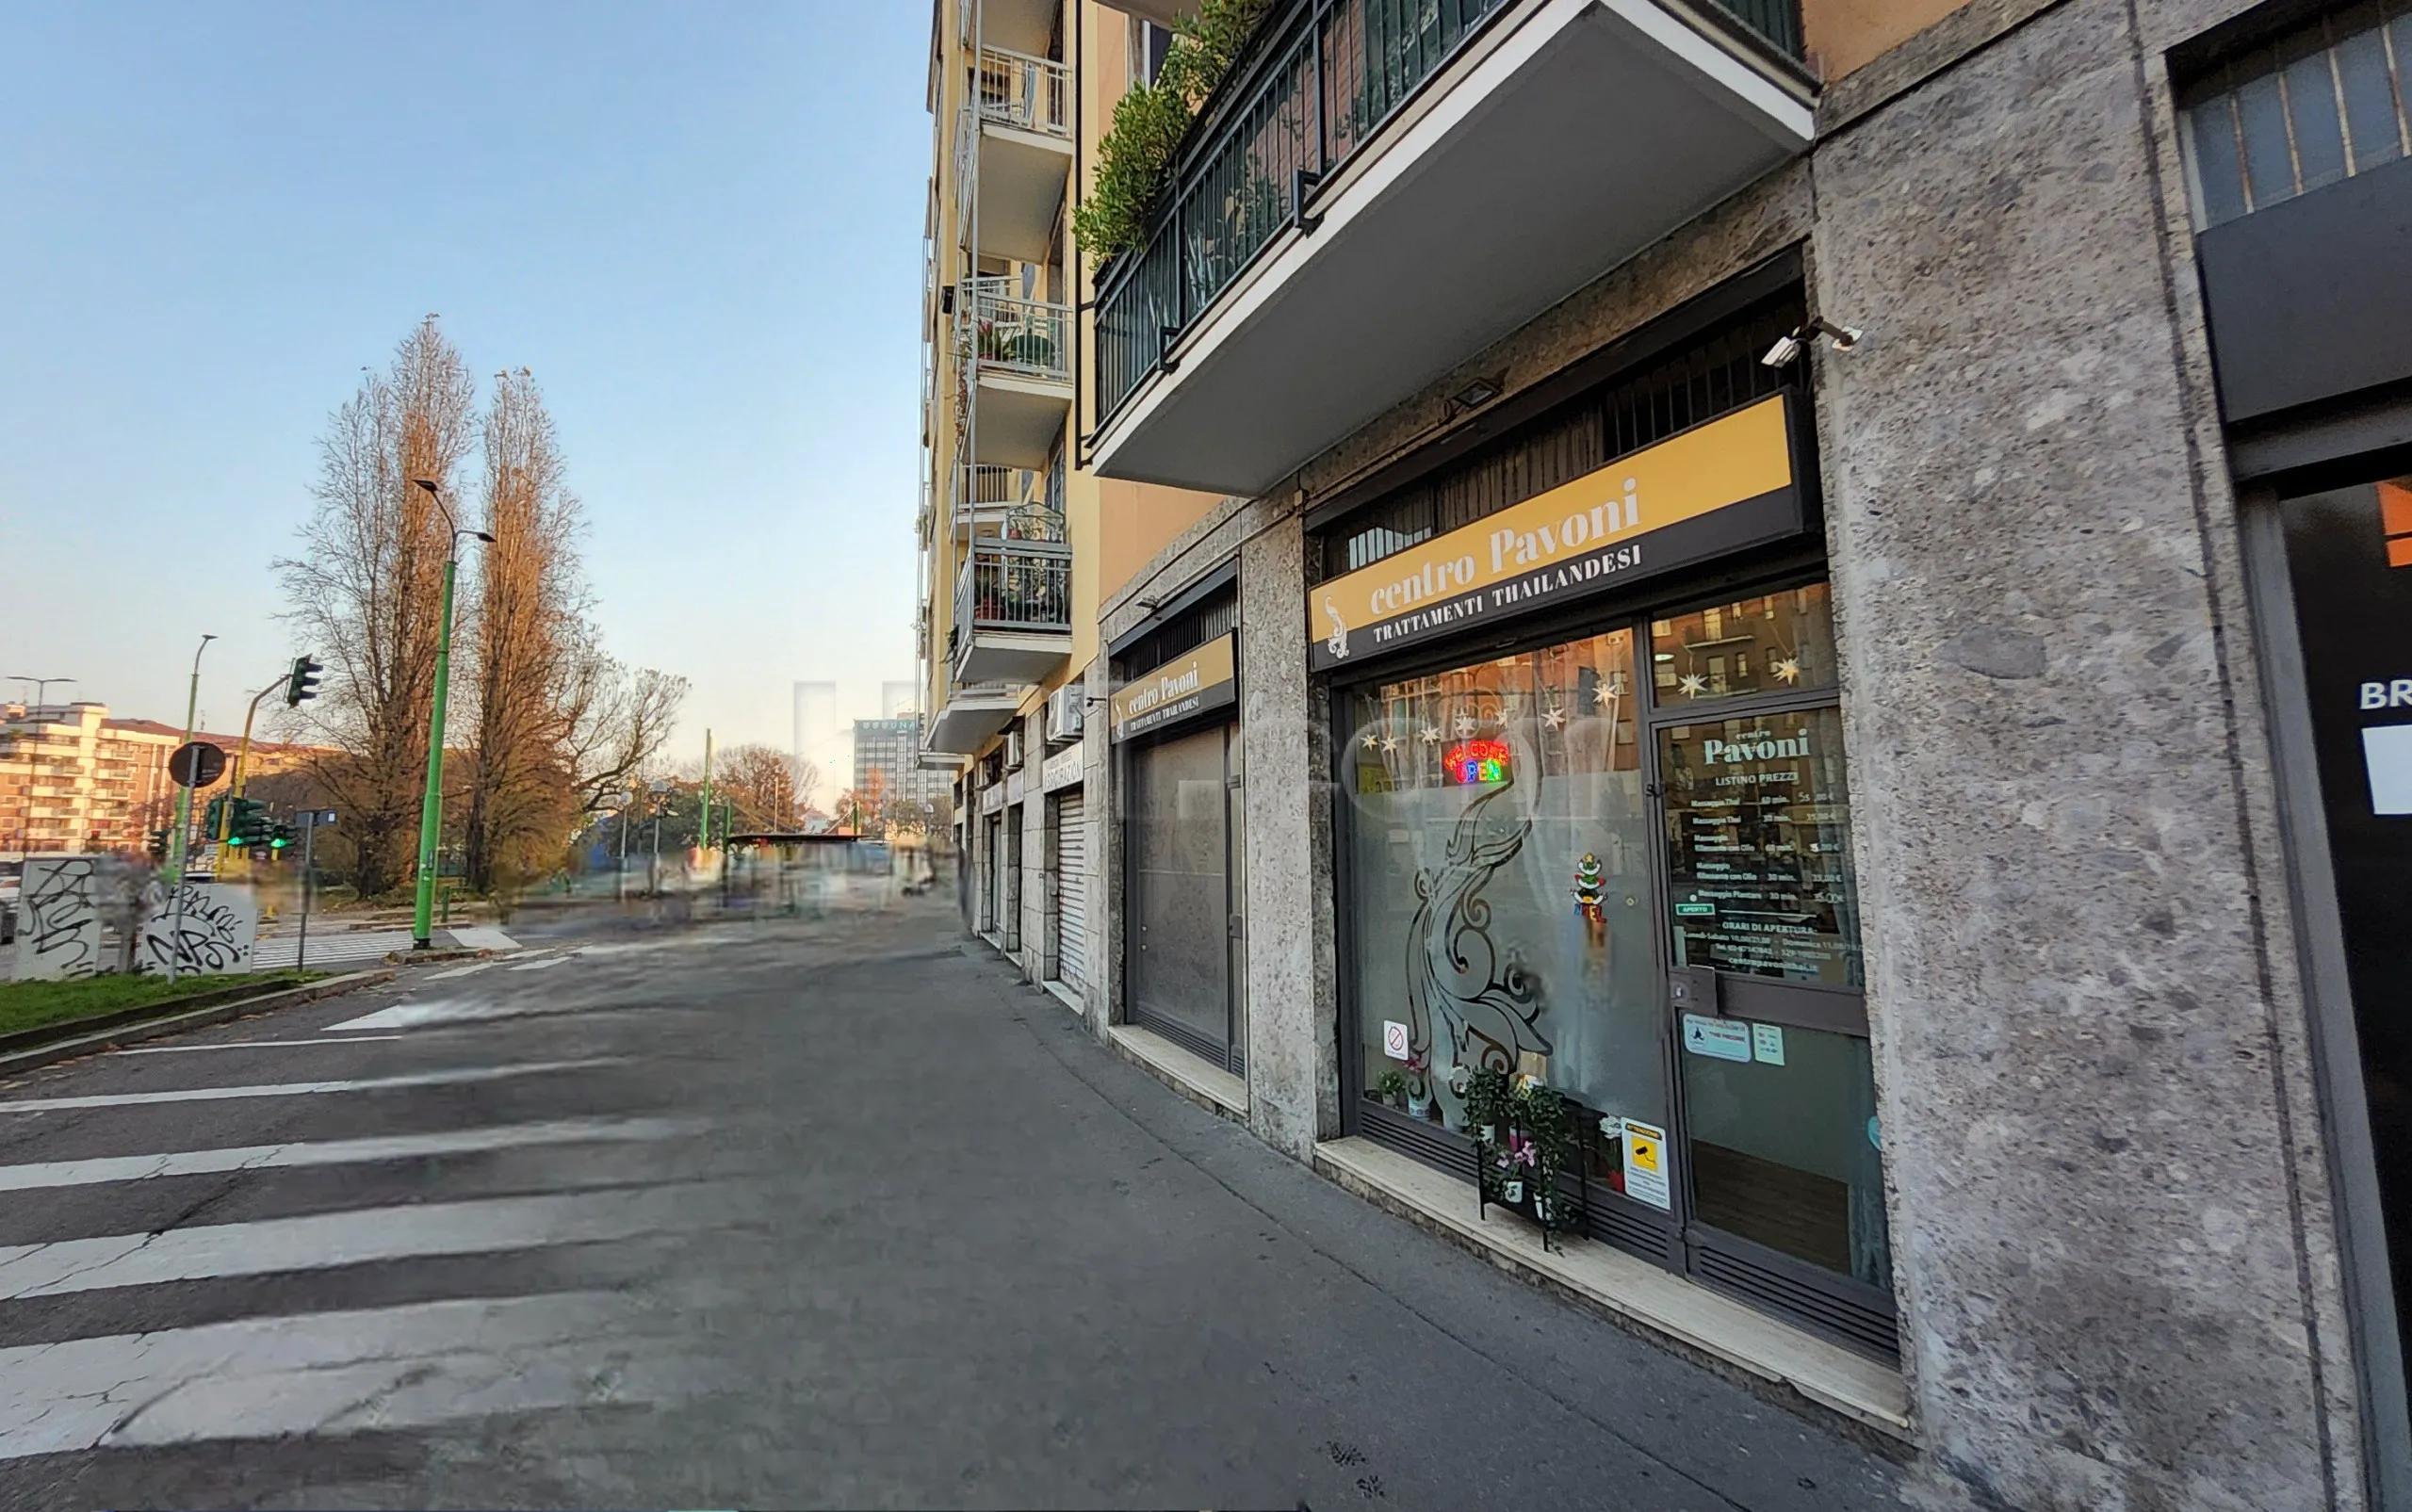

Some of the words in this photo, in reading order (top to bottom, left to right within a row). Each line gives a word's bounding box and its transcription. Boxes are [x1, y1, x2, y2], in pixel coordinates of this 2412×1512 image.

[1371, 555, 1475, 615] centro
[1490, 478, 1642, 575] Pavoni
[1374, 595, 1483, 642] TRATTAMENTI
[1492, 545, 1641, 607] THAILANDESI
[1129, 688, 1159, 714] centro
[1161, 660, 1198, 701] Pavoni
[2359, 678, 2412, 710] BR
[1703, 728, 1811, 765] Pavoni
[1456, 757, 1502, 783] OPEN
[1716, 775, 1756, 787] LISTINO
[1721, 921, 1751, 931] ORARI
